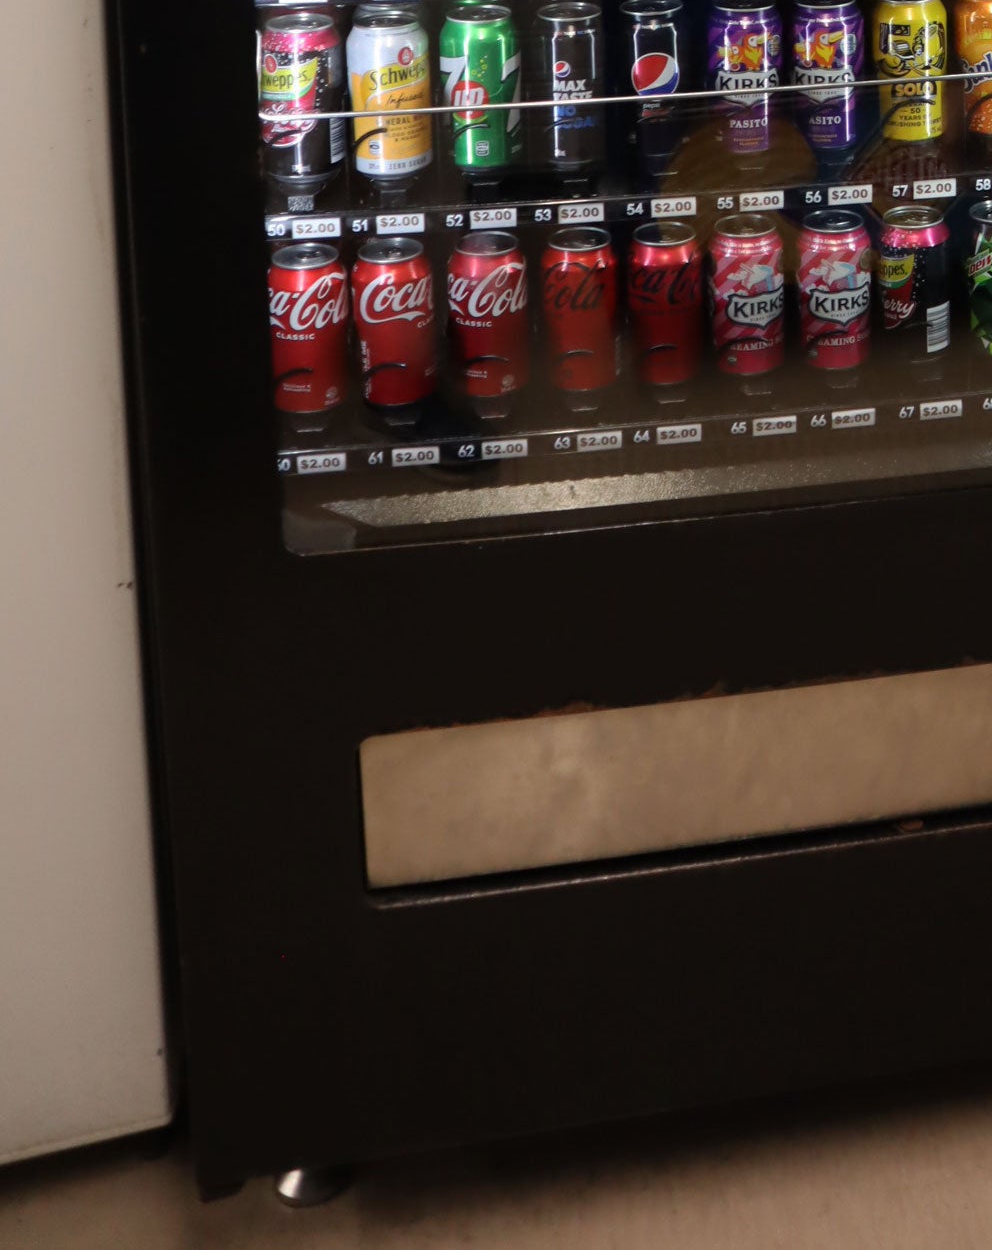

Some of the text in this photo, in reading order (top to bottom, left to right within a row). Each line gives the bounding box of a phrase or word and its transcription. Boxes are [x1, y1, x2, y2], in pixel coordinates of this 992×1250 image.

[553, 78, 586, 92] MAX
[894, 82, 934, 97] SOLO
[729, 118, 769, 129] PASITO
[892, 184, 909, 198] 57
[975, 178, 992, 191] 58
[717, 196, 734, 210] 55
[805, 190, 822, 204] 56
[534, 208, 552, 222] 53
[626, 201, 692, 216] 54 $2.00
[351, 219, 368, 232] 51
[446, 210, 512, 227] 52 $2.00
[267, 223, 335, 237] 50 $2.00
[814, 293, 870, 314] KIRKS
[455, 317, 492, 328] CLASSIC
[275, 330, 315, 342] CLASSIC
[899, 406, 915, 419] 67
[810, 414, 827, 428] 66
[633, 428, 698, 443] 64 $2.00
[730, 422, 747, 435] 65
[554, 437, 571, 450] 63
[368, 451, 384, 464] 61
[458, 444, 523, 458] 62 $2.00
[300, 458, 340, 470] $2.00
